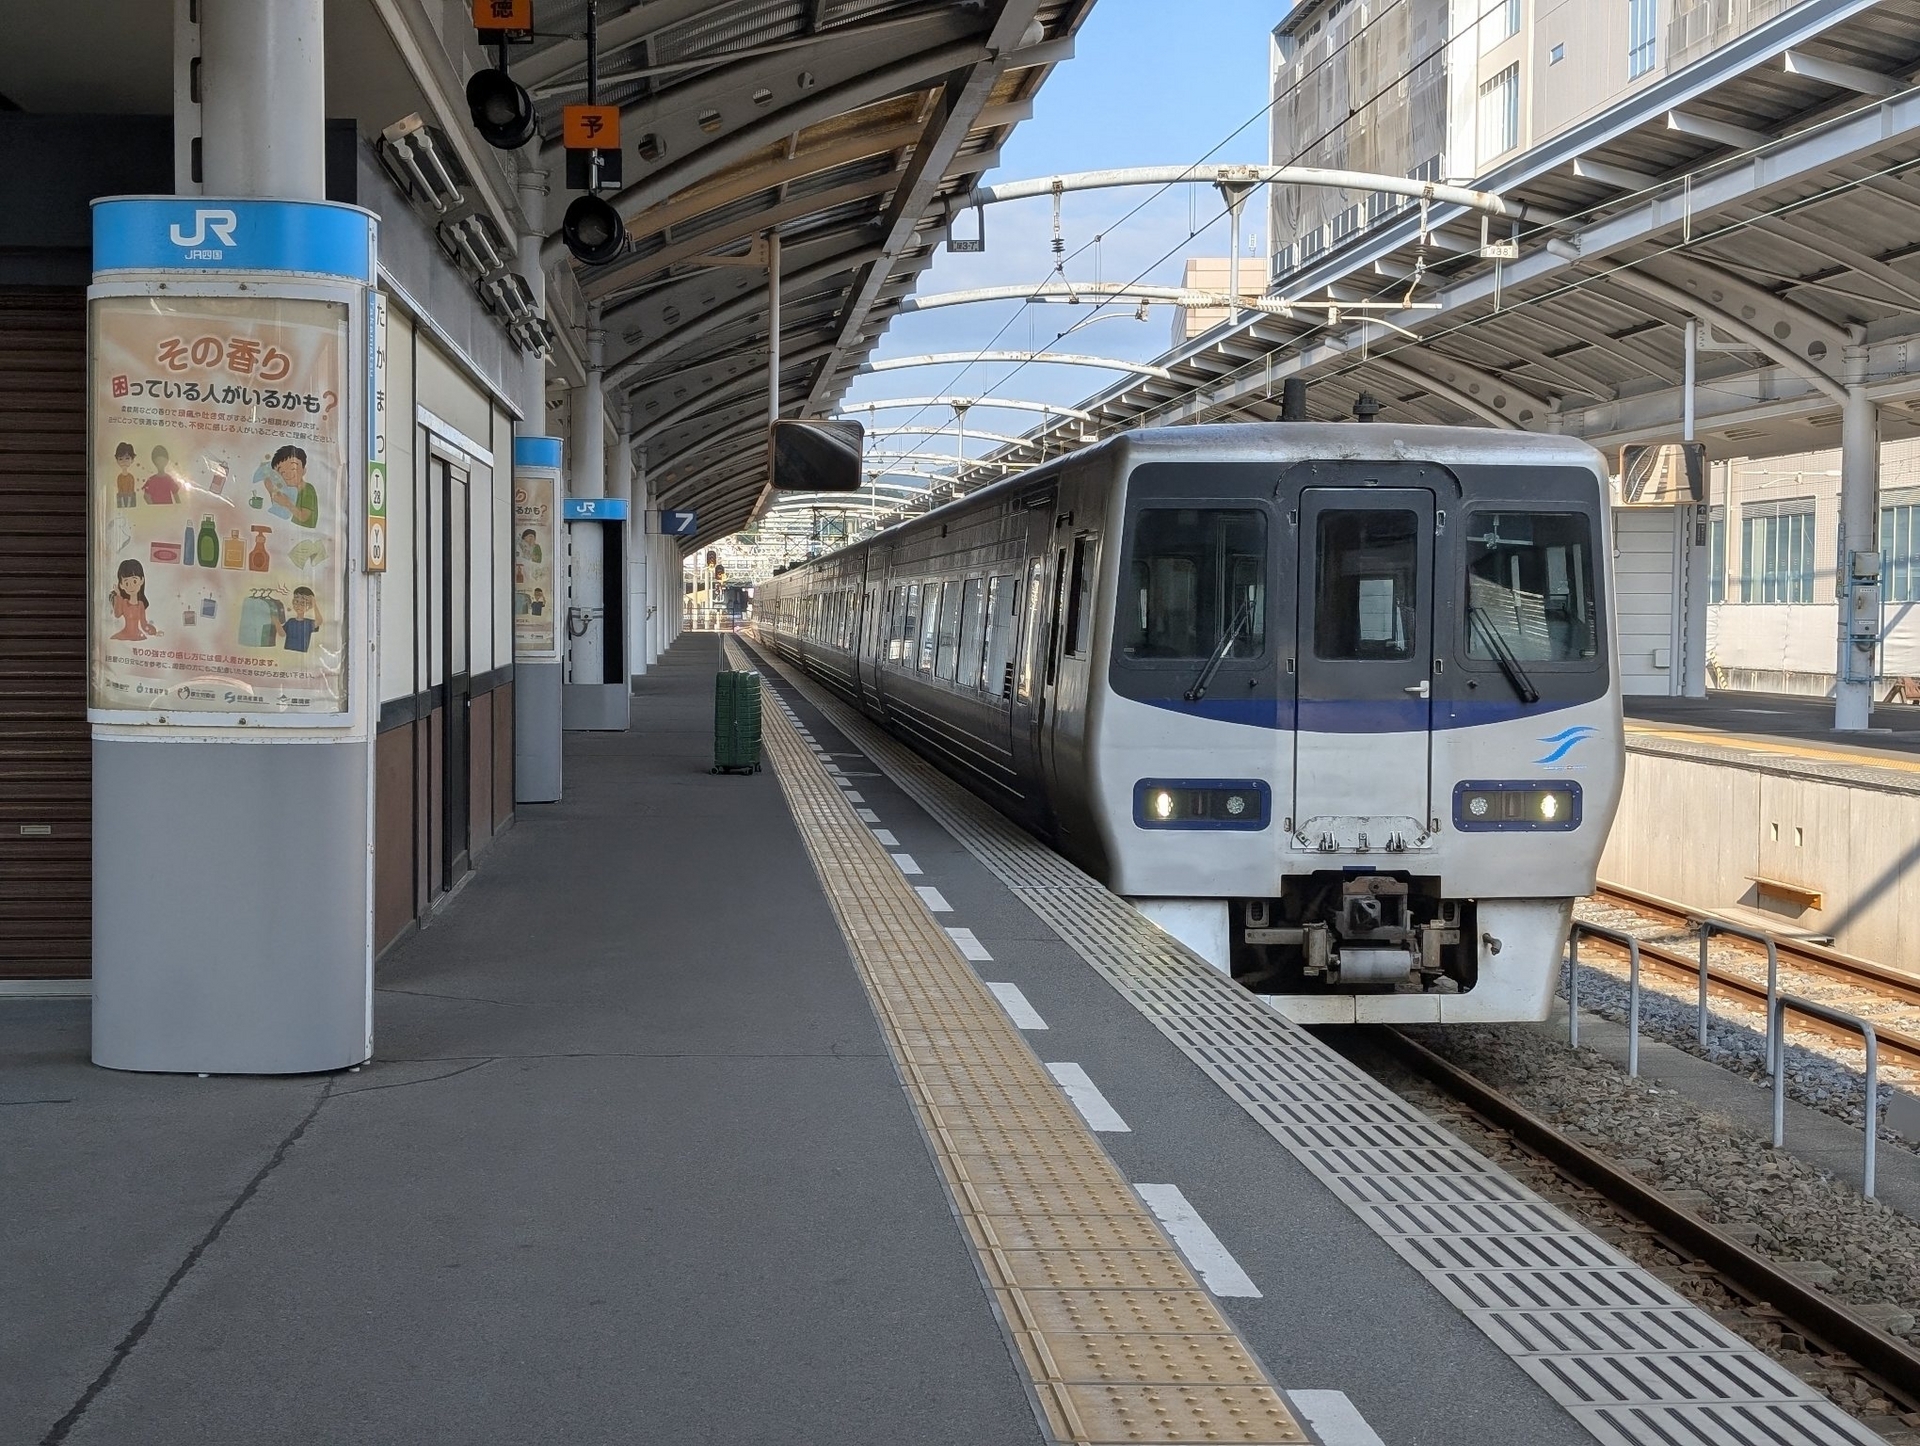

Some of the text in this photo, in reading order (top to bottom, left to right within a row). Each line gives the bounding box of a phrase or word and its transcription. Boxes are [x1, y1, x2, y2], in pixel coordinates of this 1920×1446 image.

[581, 116, 603, 138] 予
[170, 209, 237, 247] JR
[184, 249, 223, 260] JR四国
[158, 336, 290, 381] その香り
[376, 303, 386, 454] たかまつ
[112, 374, 338, 421] 困っている人がいるかも?
[576, 502, 595, 513] JR
[675, 513, 694, 532] 7
